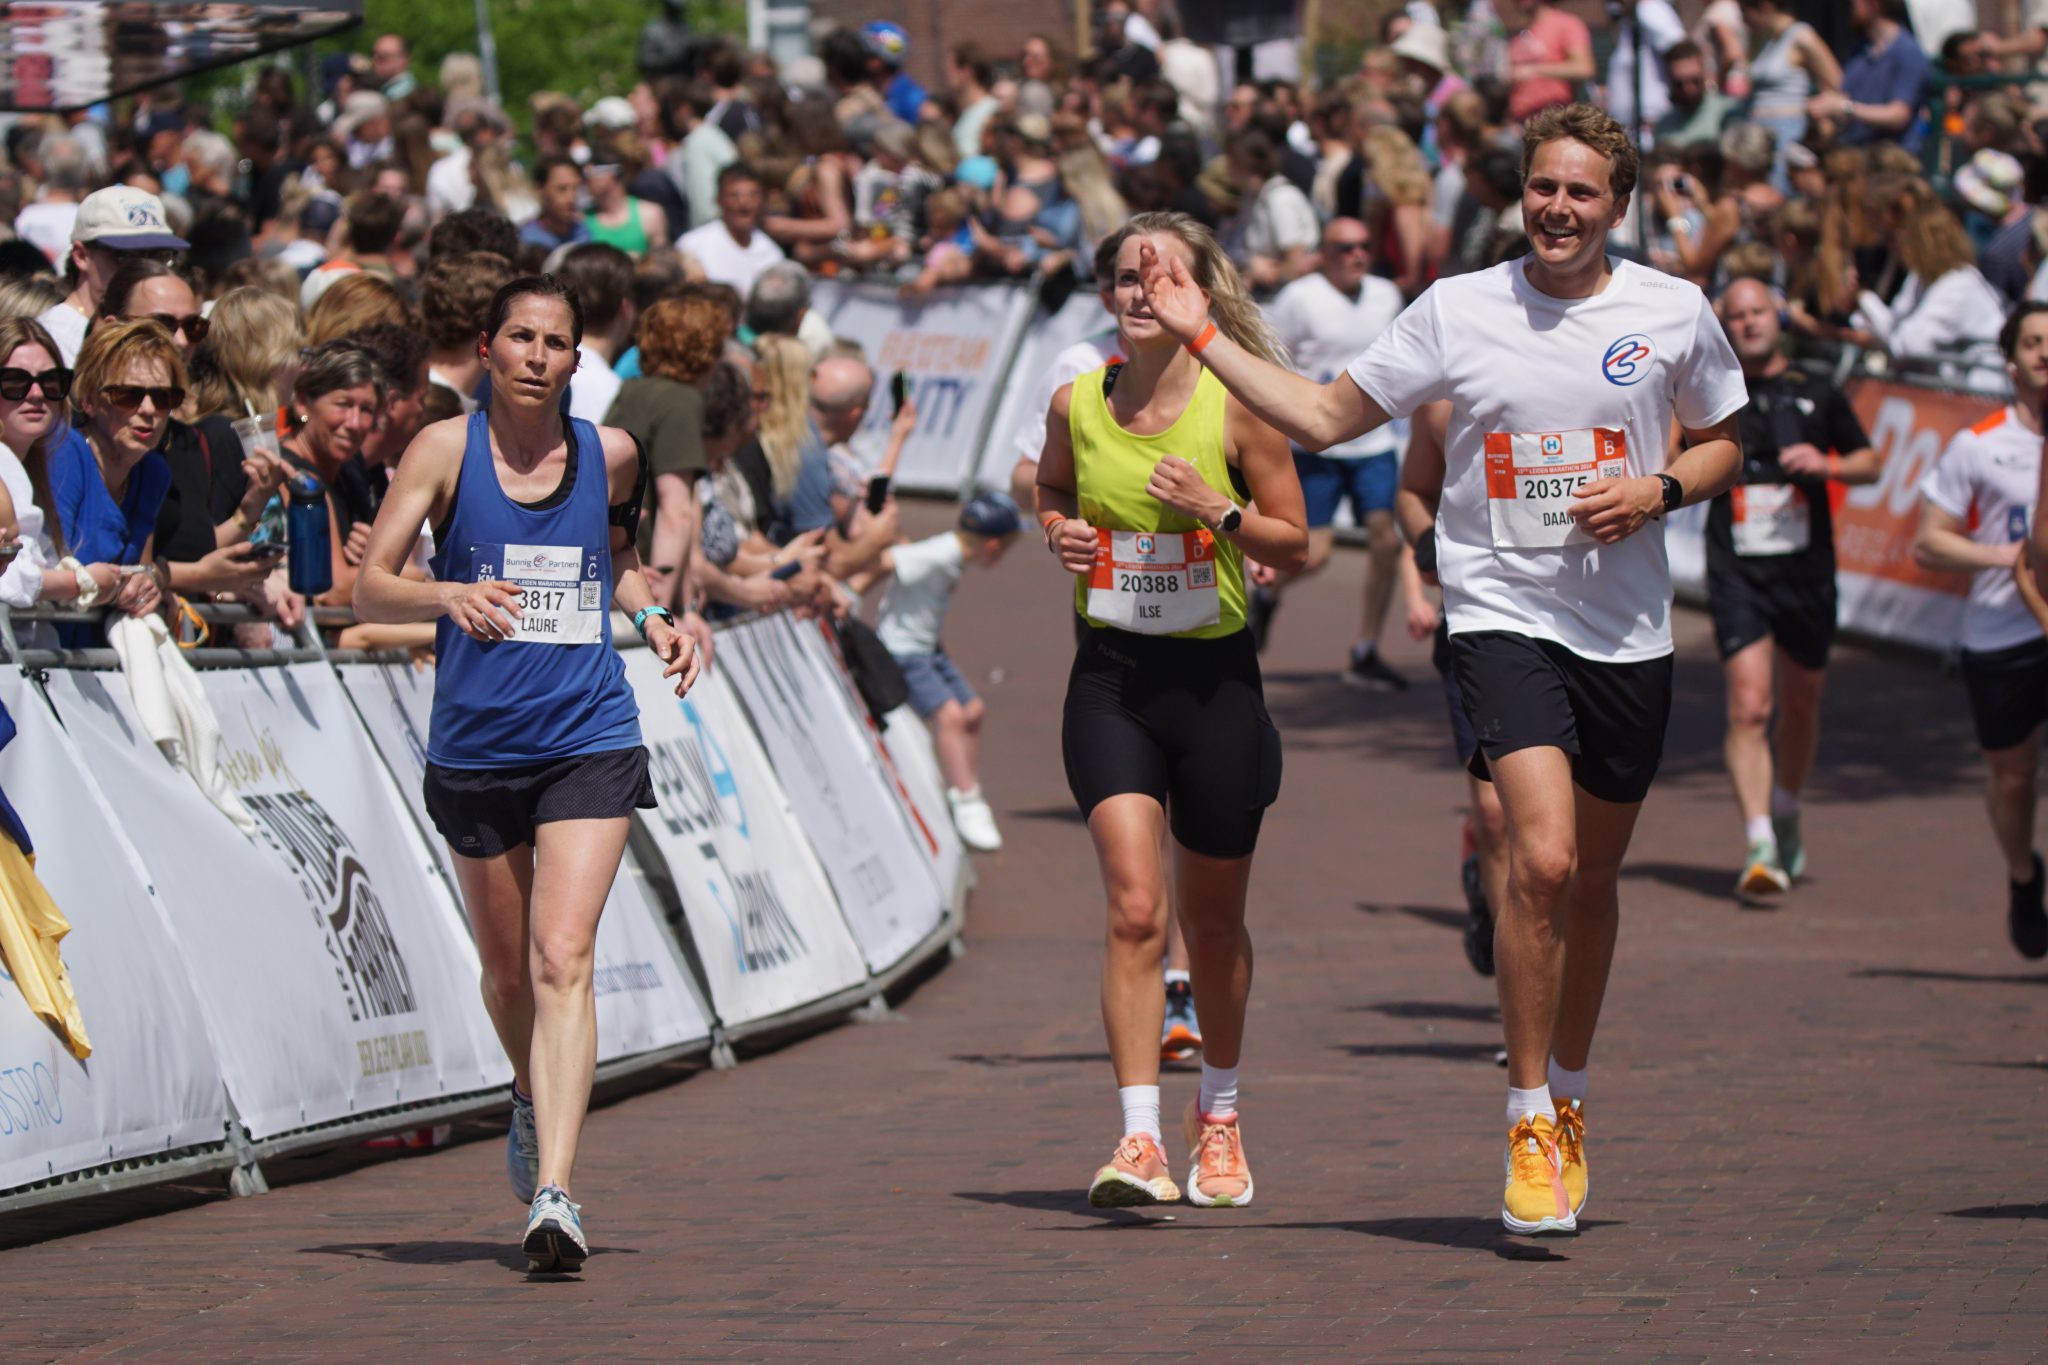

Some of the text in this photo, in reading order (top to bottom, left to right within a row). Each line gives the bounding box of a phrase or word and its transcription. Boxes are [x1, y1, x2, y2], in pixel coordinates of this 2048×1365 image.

[1546, 440, 1557, 451] H
[1604, 440, 1615, 456] B
[1549, 465, 1580, 473] MARATHON
[1543, 512, 1575, 526] DAAN
[1193, 545, 1204, 558] D
[480, 564, 493, 574] 21
[506, 558, 579, 568] Bunnig Partners
[588, 562, 597, 578] C
[477, 574, 495, 582] KM
[1121, 574, 1179, 593] 20388
[519, 590, 565, 611] 3817
[1139, 605, 1162, 618] ILSE
[521, 617, 558, 633] LAURE
